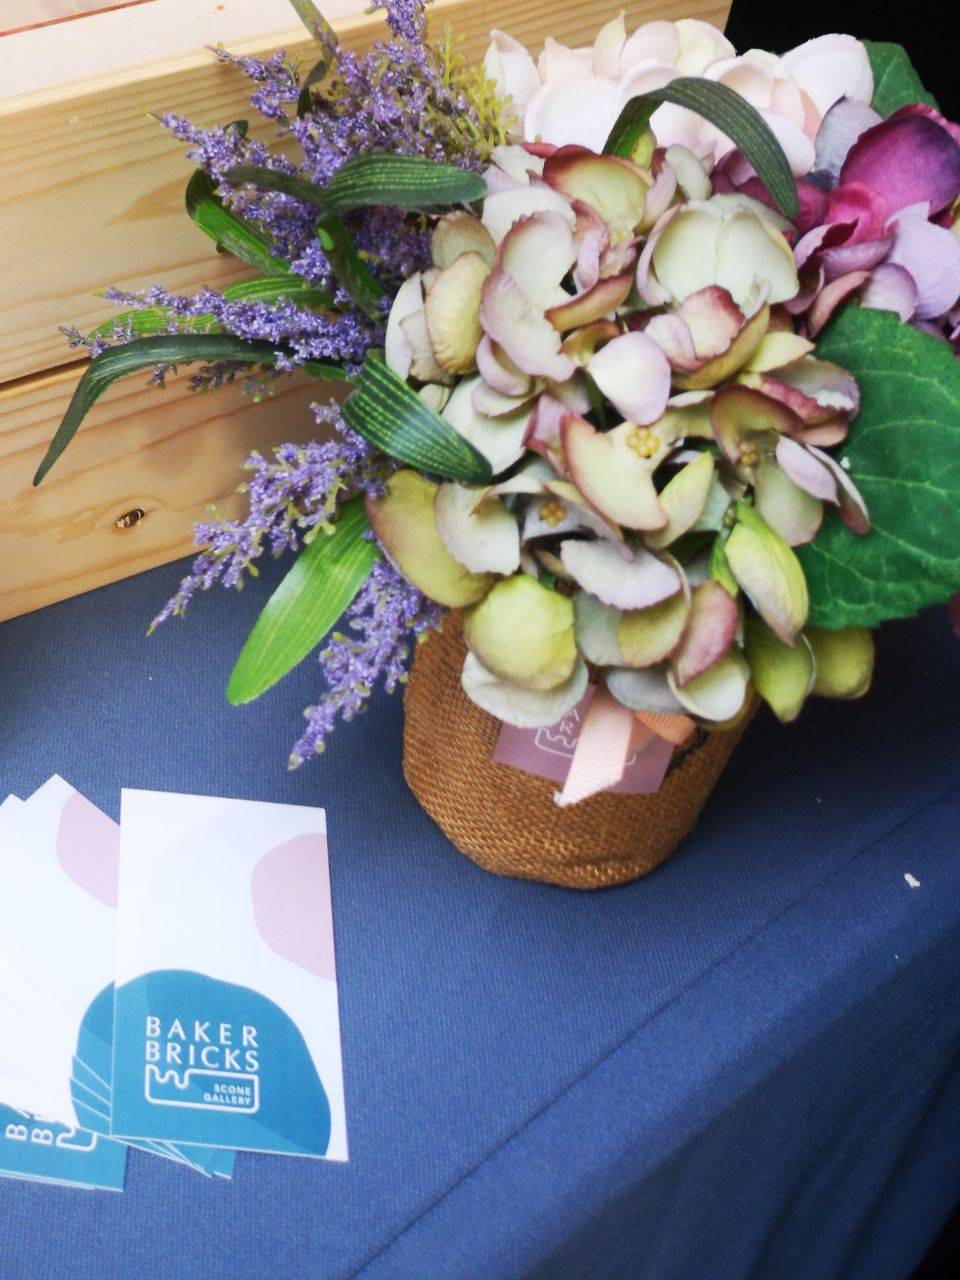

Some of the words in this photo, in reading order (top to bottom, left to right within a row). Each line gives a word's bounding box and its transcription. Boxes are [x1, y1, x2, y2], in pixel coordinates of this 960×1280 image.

[145, 1015, 259, 1048] BAKER
[145, 1040, 259, 1072] BRICKS
[203, 1093, 251, 1105] GALLERY
[214, 1083, 251, 1095] SCONE
